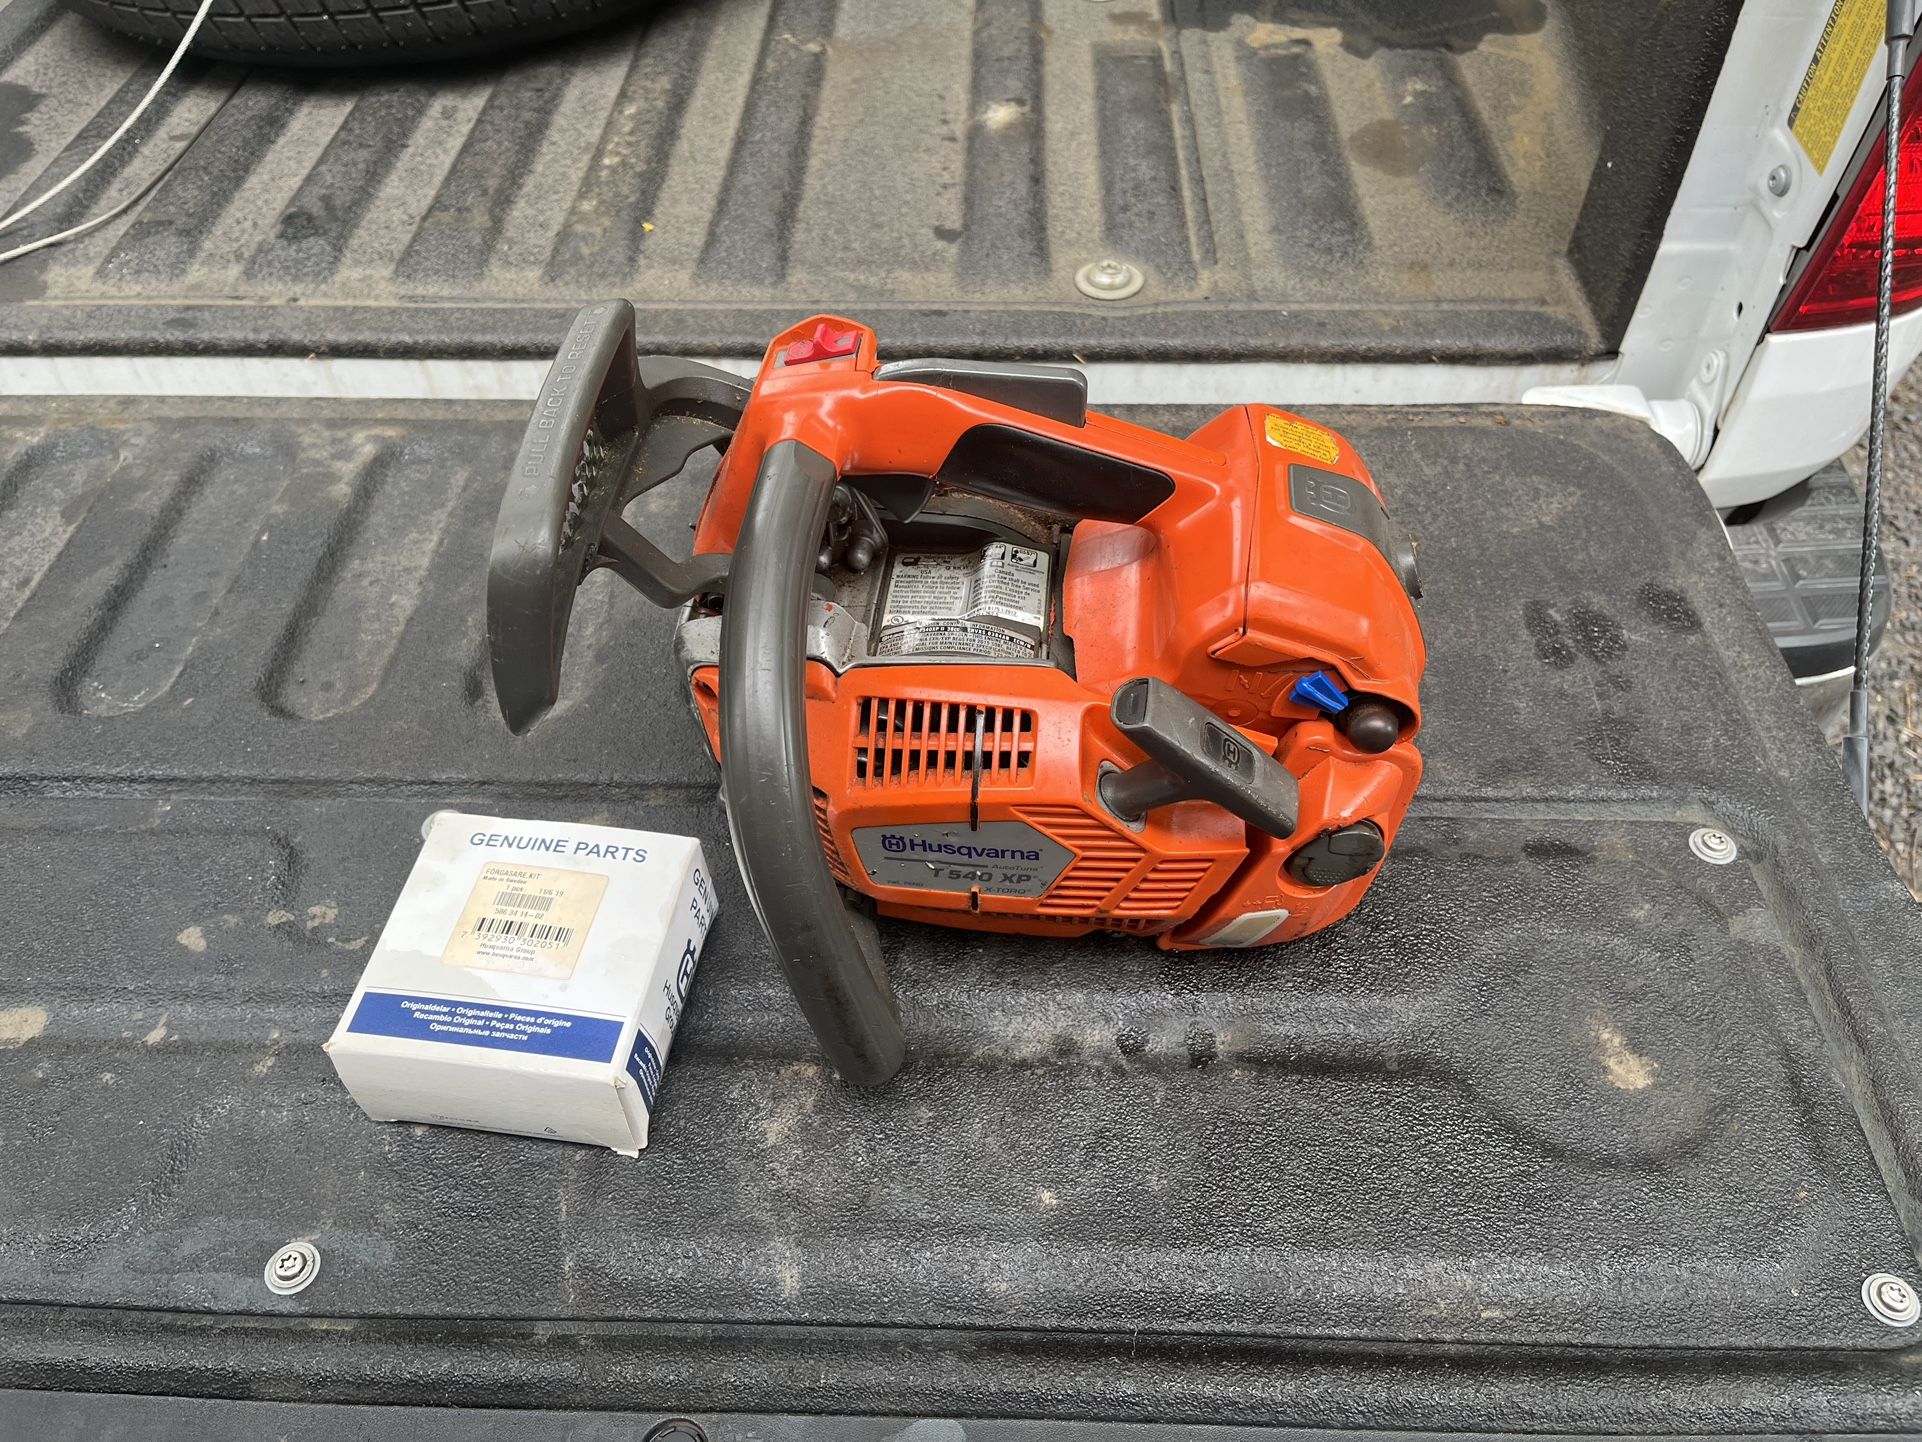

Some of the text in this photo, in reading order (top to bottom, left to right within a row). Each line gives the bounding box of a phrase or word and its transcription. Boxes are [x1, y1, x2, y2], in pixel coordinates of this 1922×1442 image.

[1796, 0, 1843, 108] CAUTION ATTENTION
[524, 316, 598, 478] PULL BACK TO RESET
[470, 832, 648, 863] GENUINE PARTS
[909, 838, 1039, 861] Husqvarna
[932, 868, 1032, 884] T 540 XP
[474, 933, 515, 944] 392930
[520, 938, 560, 950] 302051
[480, 942, 536, 956] Husqvarna Group
[401, 1001, 450, 1013] Originaldelar
[456, 1006, 503, 1019] Originalteile
[536, 1017, 572, 1028] d'origine
[413, 1012, 551, 1034] Recambio Original Peças Originais
[430, 1023, 528, 1041] Оригинальные запчасти
